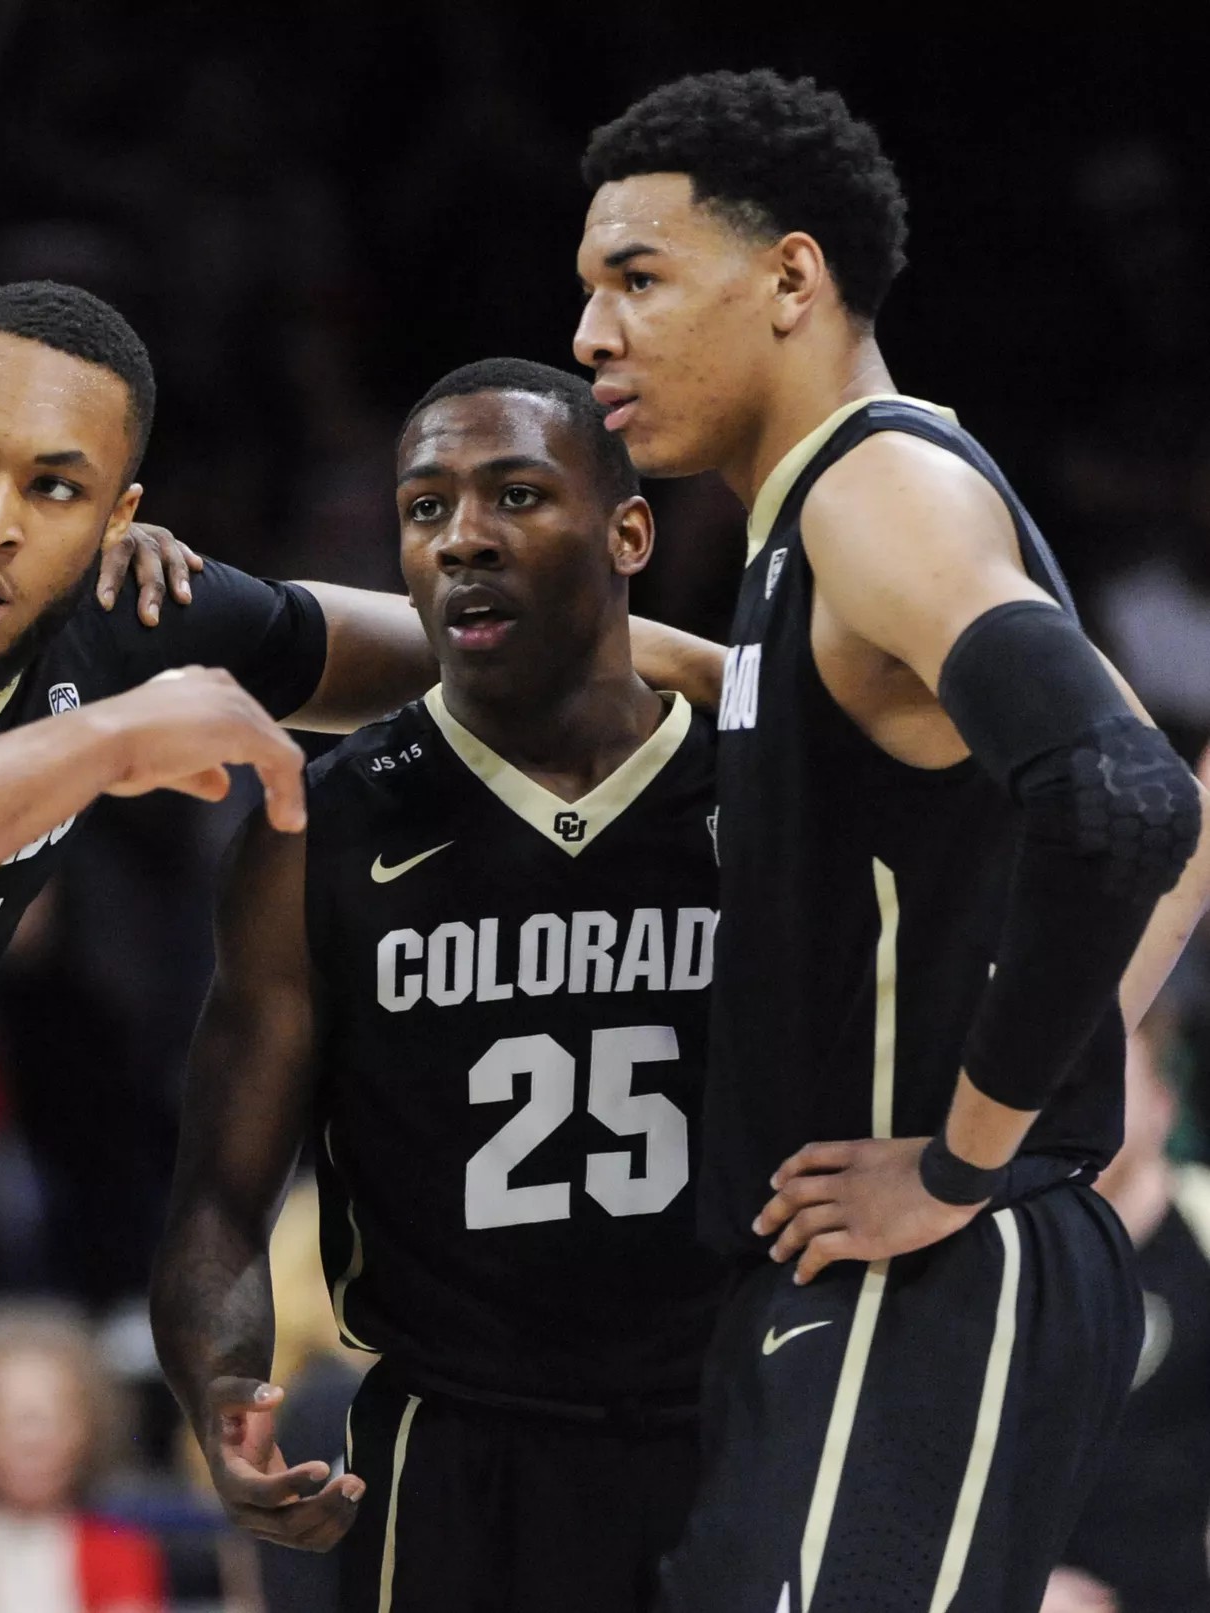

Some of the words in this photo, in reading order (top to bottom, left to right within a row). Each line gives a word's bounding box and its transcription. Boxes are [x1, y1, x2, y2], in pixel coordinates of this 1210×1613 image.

[371, 756, 396, 772] JS
[399, 743, 422, 763] 15
[553, 811, 588, 842] CU
[377, 908, 720, 1012] COLORAD
[465, 1026, 688, 1229] 25
